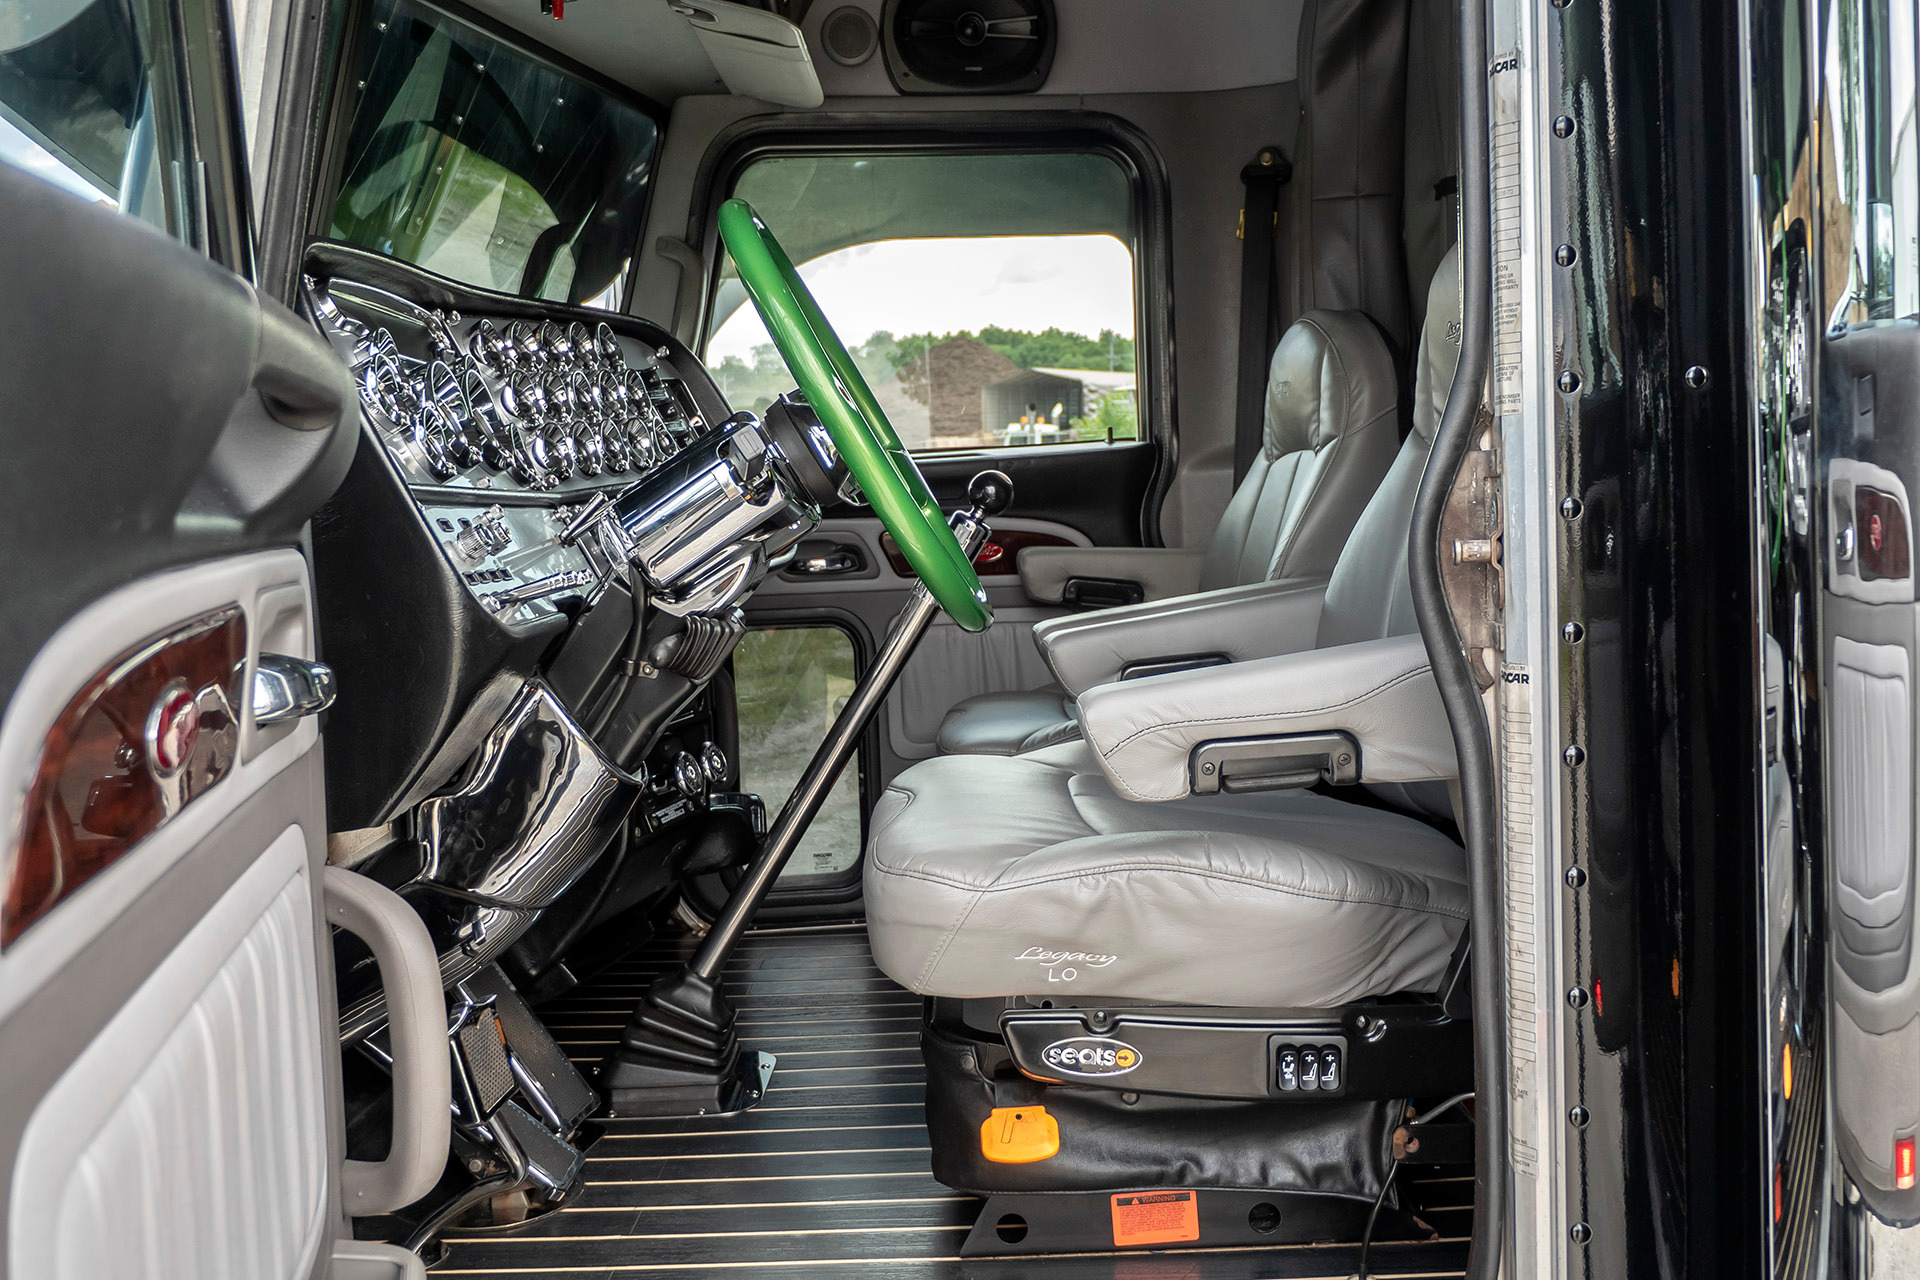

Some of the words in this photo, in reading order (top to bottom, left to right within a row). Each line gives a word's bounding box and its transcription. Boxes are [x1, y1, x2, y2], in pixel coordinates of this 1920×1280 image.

[1014, 946, 1118, 968] Legacy
[1048, 968, 1077, 982] LO
[1047, 1046, 1116, 1067] seats
[1141, 1194, 1177, 1204] WARNING
